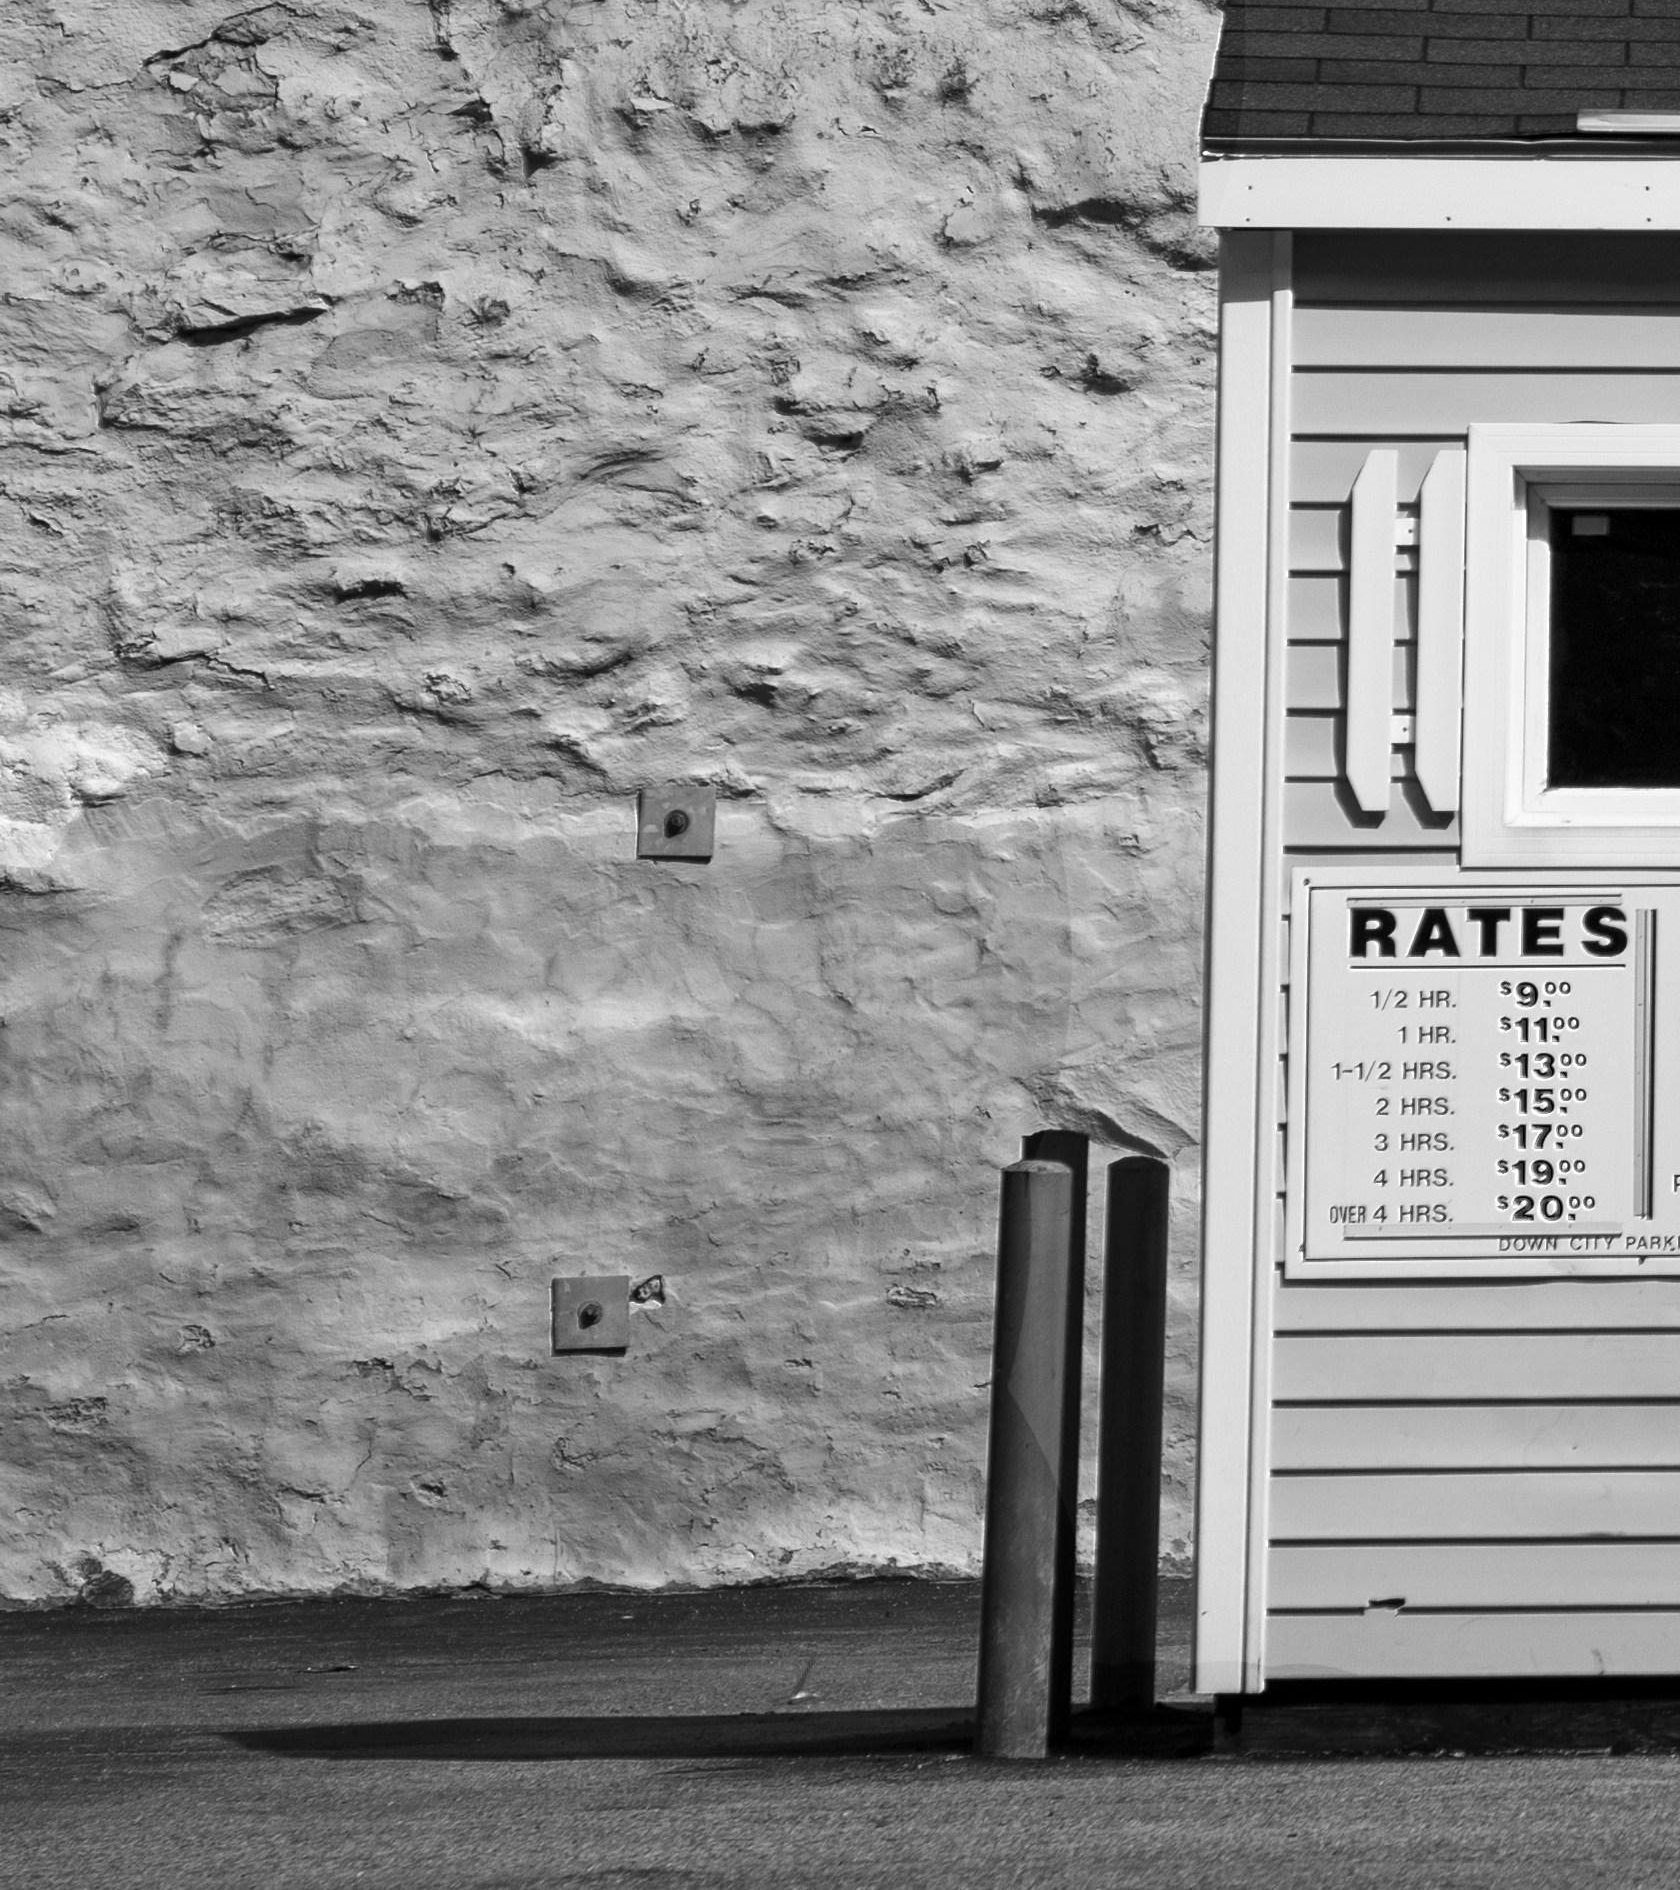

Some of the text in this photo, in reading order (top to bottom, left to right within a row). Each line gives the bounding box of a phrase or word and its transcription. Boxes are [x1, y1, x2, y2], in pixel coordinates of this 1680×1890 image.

[1349, 907, 1628, 958] RATES
[1370, 990, 1408, 1010] 1/2
[1419, 991, 1457, 1008] HR.
[1397, 1026, 1407, 1044] 1
[1418, 1026, 1457, 1044] HR.
[1331, 1061, 1391, 1082] 1-1/2
[1402, 1062, 1457, 1080] HRS.
[1376, 1098, 1389, 1115] 2
[1401, 1097, 1455, 1115] HRS.
[1374, 1134, 1388, 1151] 3
[1400, 1133, 1454, 1151] HRS.
[1373, 1169, 1388, 1187] 4
[1400, 1169, 1454, 1187] HRS.
[1329, 1205, 1366, 1223] OVER
[1373, 1205, 1387, 1222] 4
[1399, 1205, 1454, 1222] HRS.
[1500, 1236, 1557, 1251] DOWN
[1570, 1236, 1614, 1250] CITY
